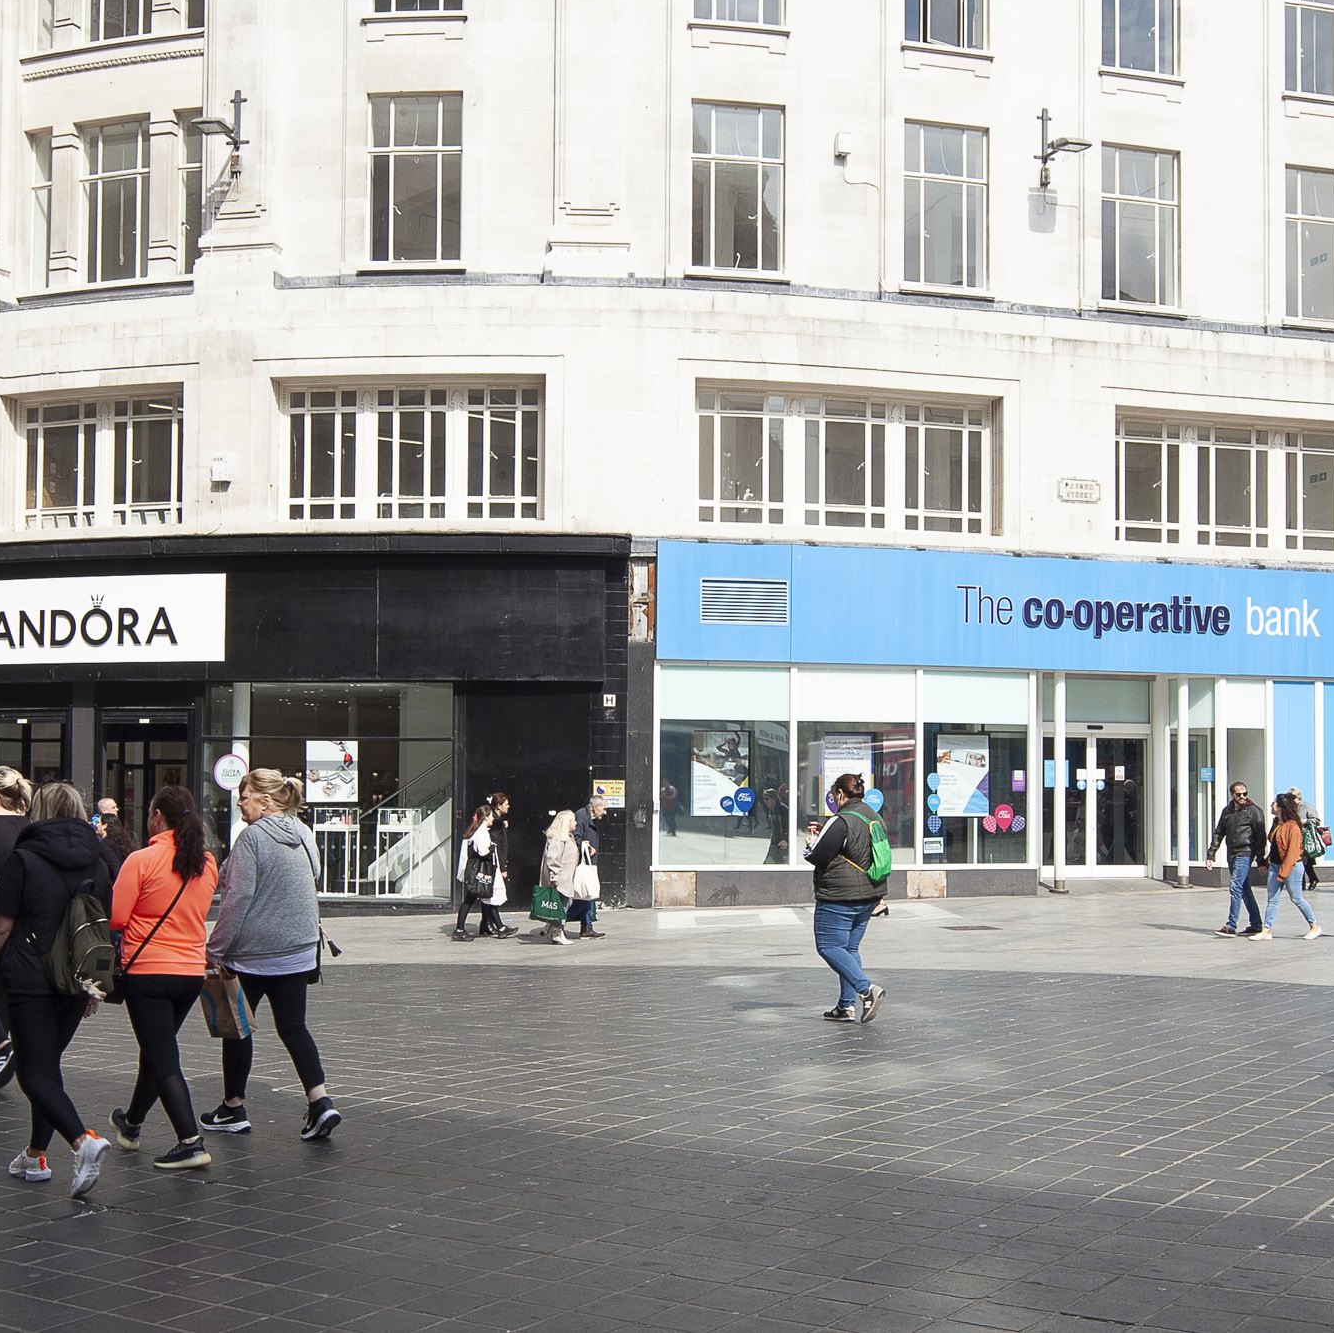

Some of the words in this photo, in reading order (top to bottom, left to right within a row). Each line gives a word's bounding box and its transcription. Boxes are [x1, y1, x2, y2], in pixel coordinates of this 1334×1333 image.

[957, 585, 1013, 625] The
[1022, 595, 1231, 639] co-operative
[1246, 597, 1321, 638] bank
[541, 900, 558, 910] M&S
